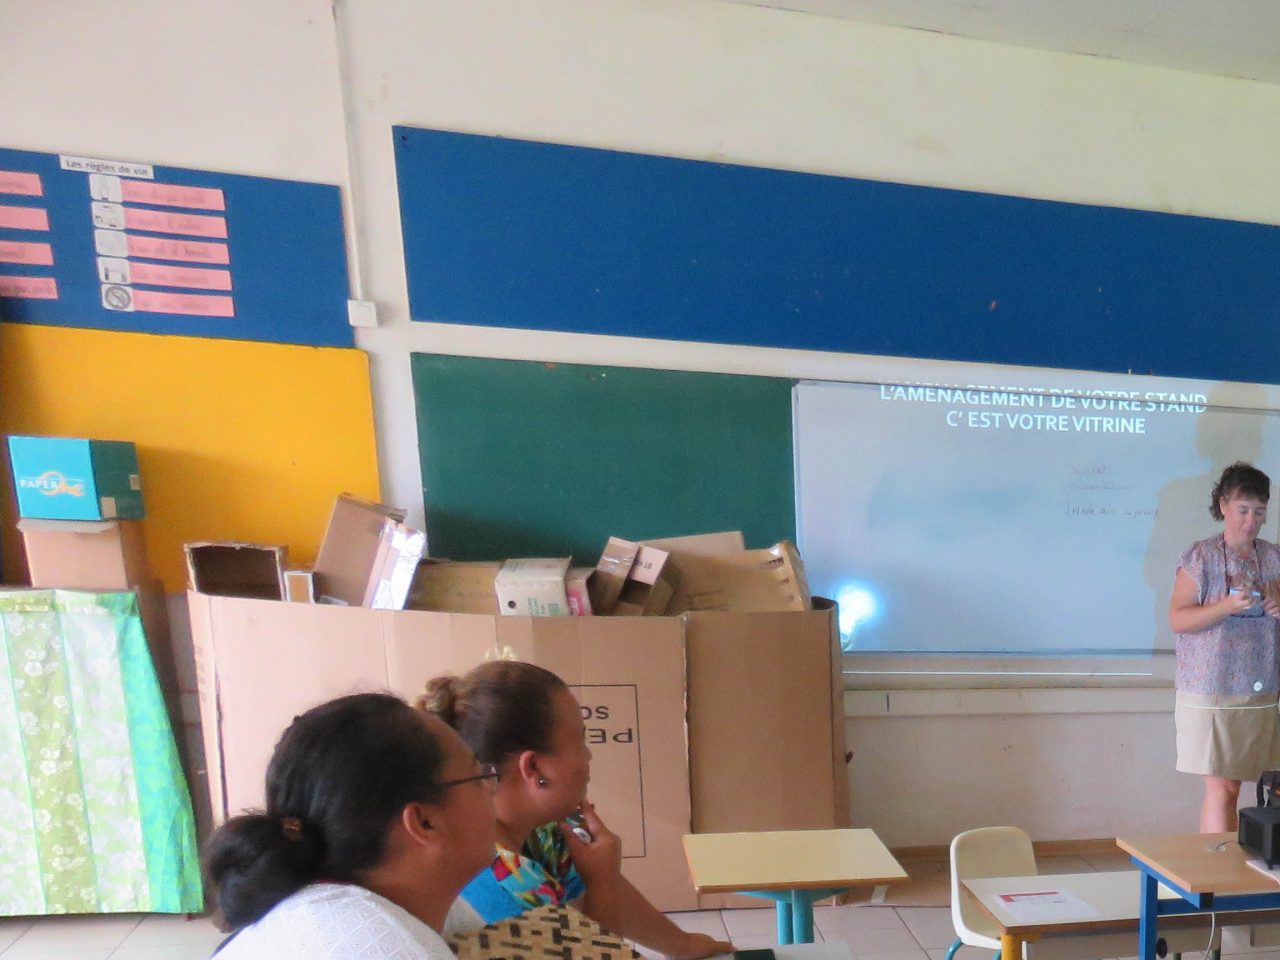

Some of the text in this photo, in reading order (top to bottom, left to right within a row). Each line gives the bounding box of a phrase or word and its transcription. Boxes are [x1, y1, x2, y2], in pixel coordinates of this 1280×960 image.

[65, 159, 81, 169] Les
[118, 165, 131, 174] de
[133, 168, 148, 176] vie
[1050, 388, 1076, 409] DE
[1078, 389, 1142, 412] VOTRE
[1145, 391, 1208, 414] STAND
[968, 411, 1005, 429] EST
[1006, 413, 1069, 431] VOTRE
[1072, 416, 1146, 434] VITRINE
